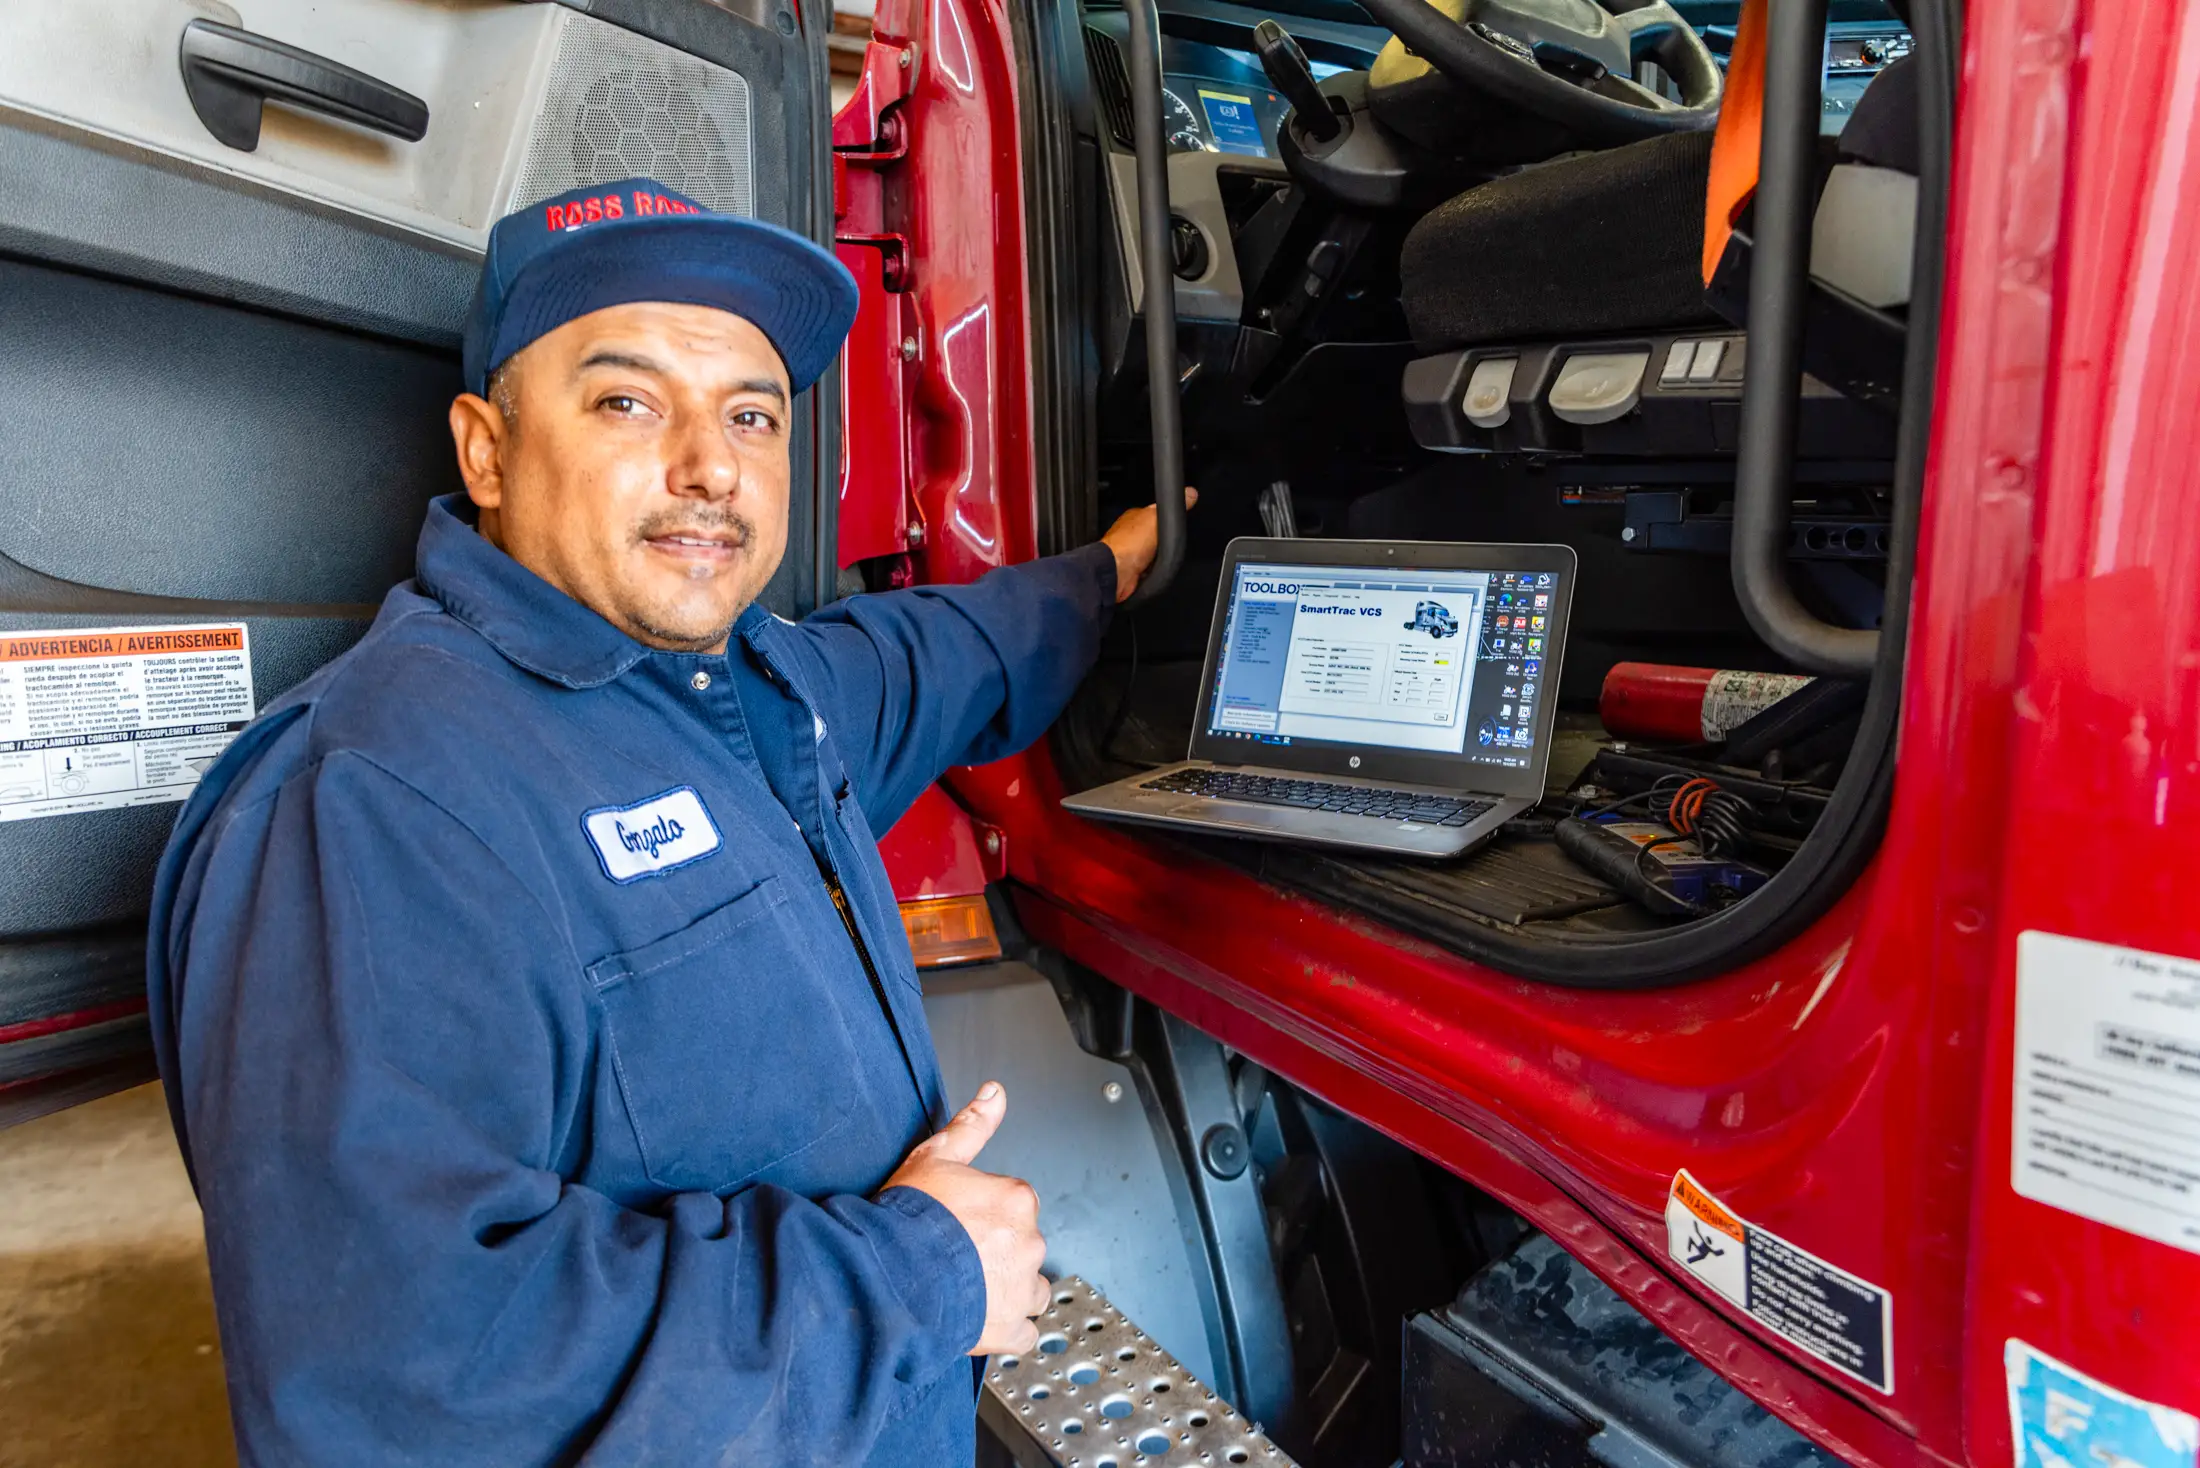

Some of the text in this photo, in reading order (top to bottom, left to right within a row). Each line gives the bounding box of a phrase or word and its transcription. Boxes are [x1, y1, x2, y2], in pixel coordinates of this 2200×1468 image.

[545, 194, 624, 232] ROSS
[1300, 604, 1382, 617] SmartTrac VCS
[9, 632, 240, 657] ADVERTENCIA / AVERTISSEMENT
[23, 736, 86, 750] ACOPLAMIENTO
[87, 731, 129, 744] CORRECTO
[135, 726, 194, 739] ACCOUPLEMENT
[195, 723, 228, 734] CORRECT
[1685, 1189, 1740, 1236] WARNING
